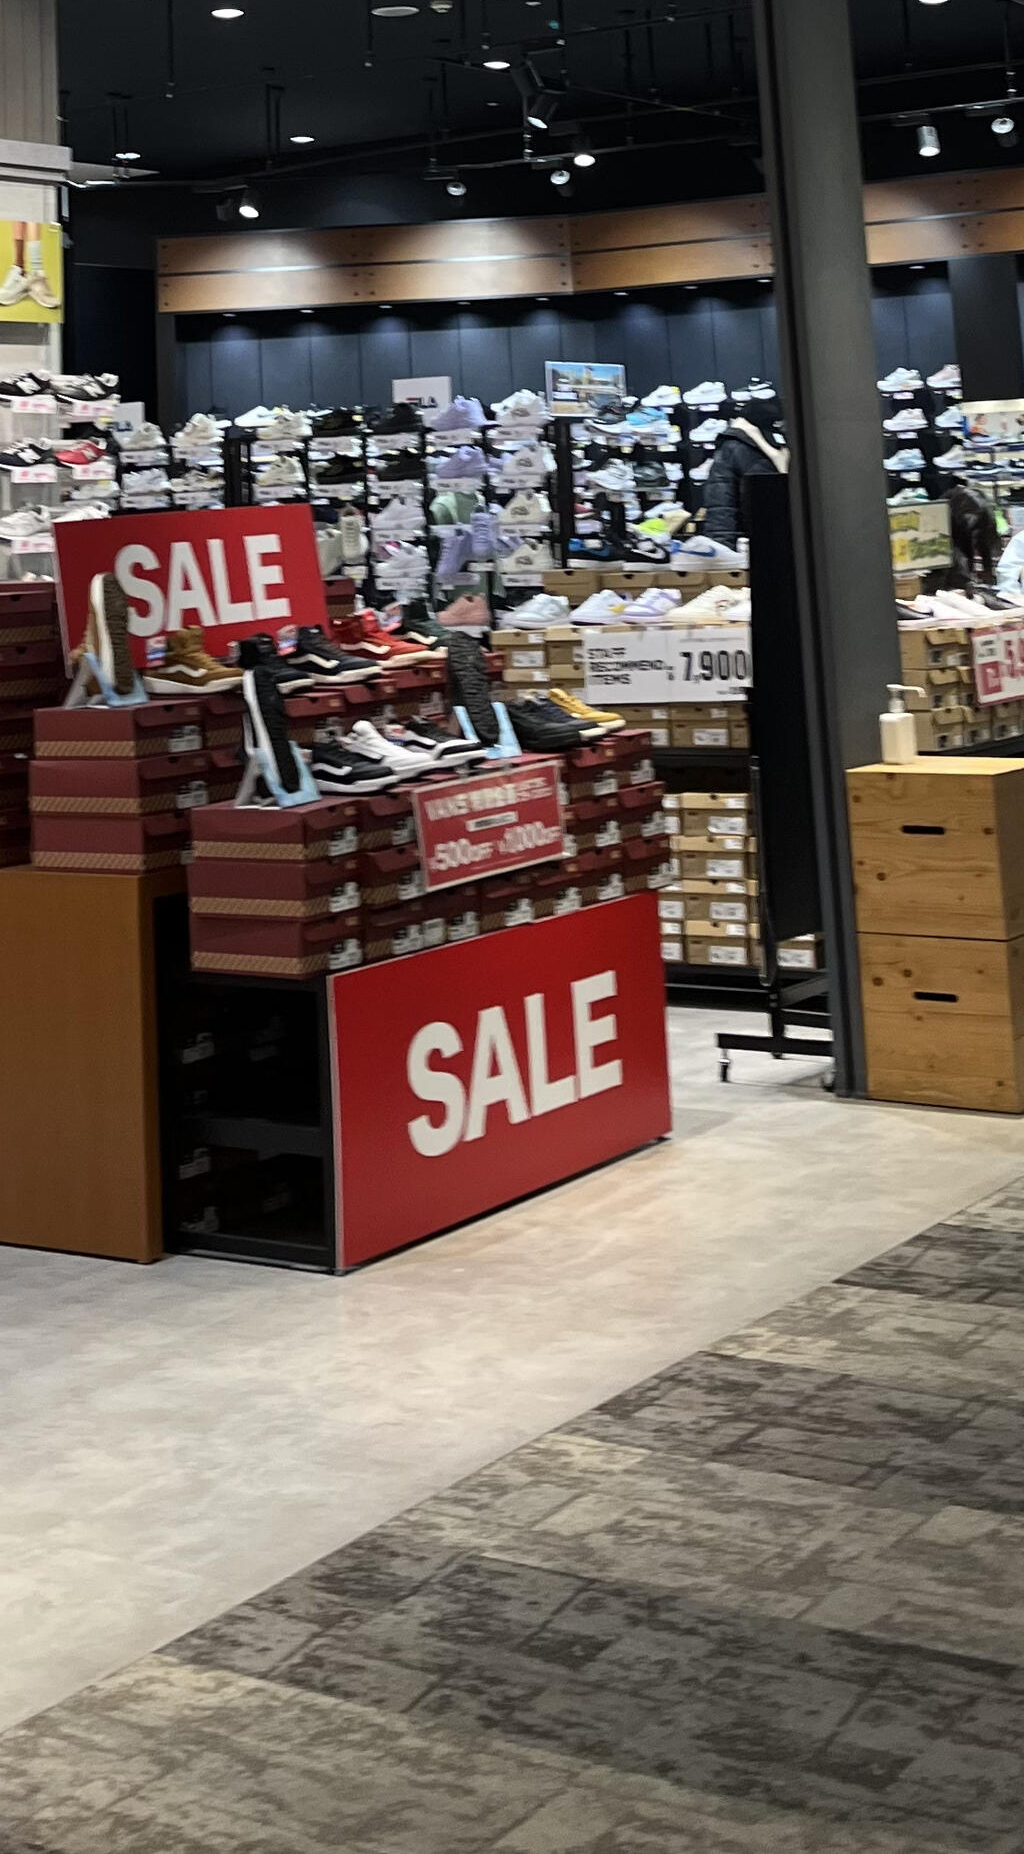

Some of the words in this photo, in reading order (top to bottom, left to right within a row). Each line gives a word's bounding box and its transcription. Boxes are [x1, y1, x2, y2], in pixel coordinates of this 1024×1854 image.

[113, 532, 293, 638] SALE
[679, 649, 748, 684] 7,900
[407, 969, 624, 1158] SALE
